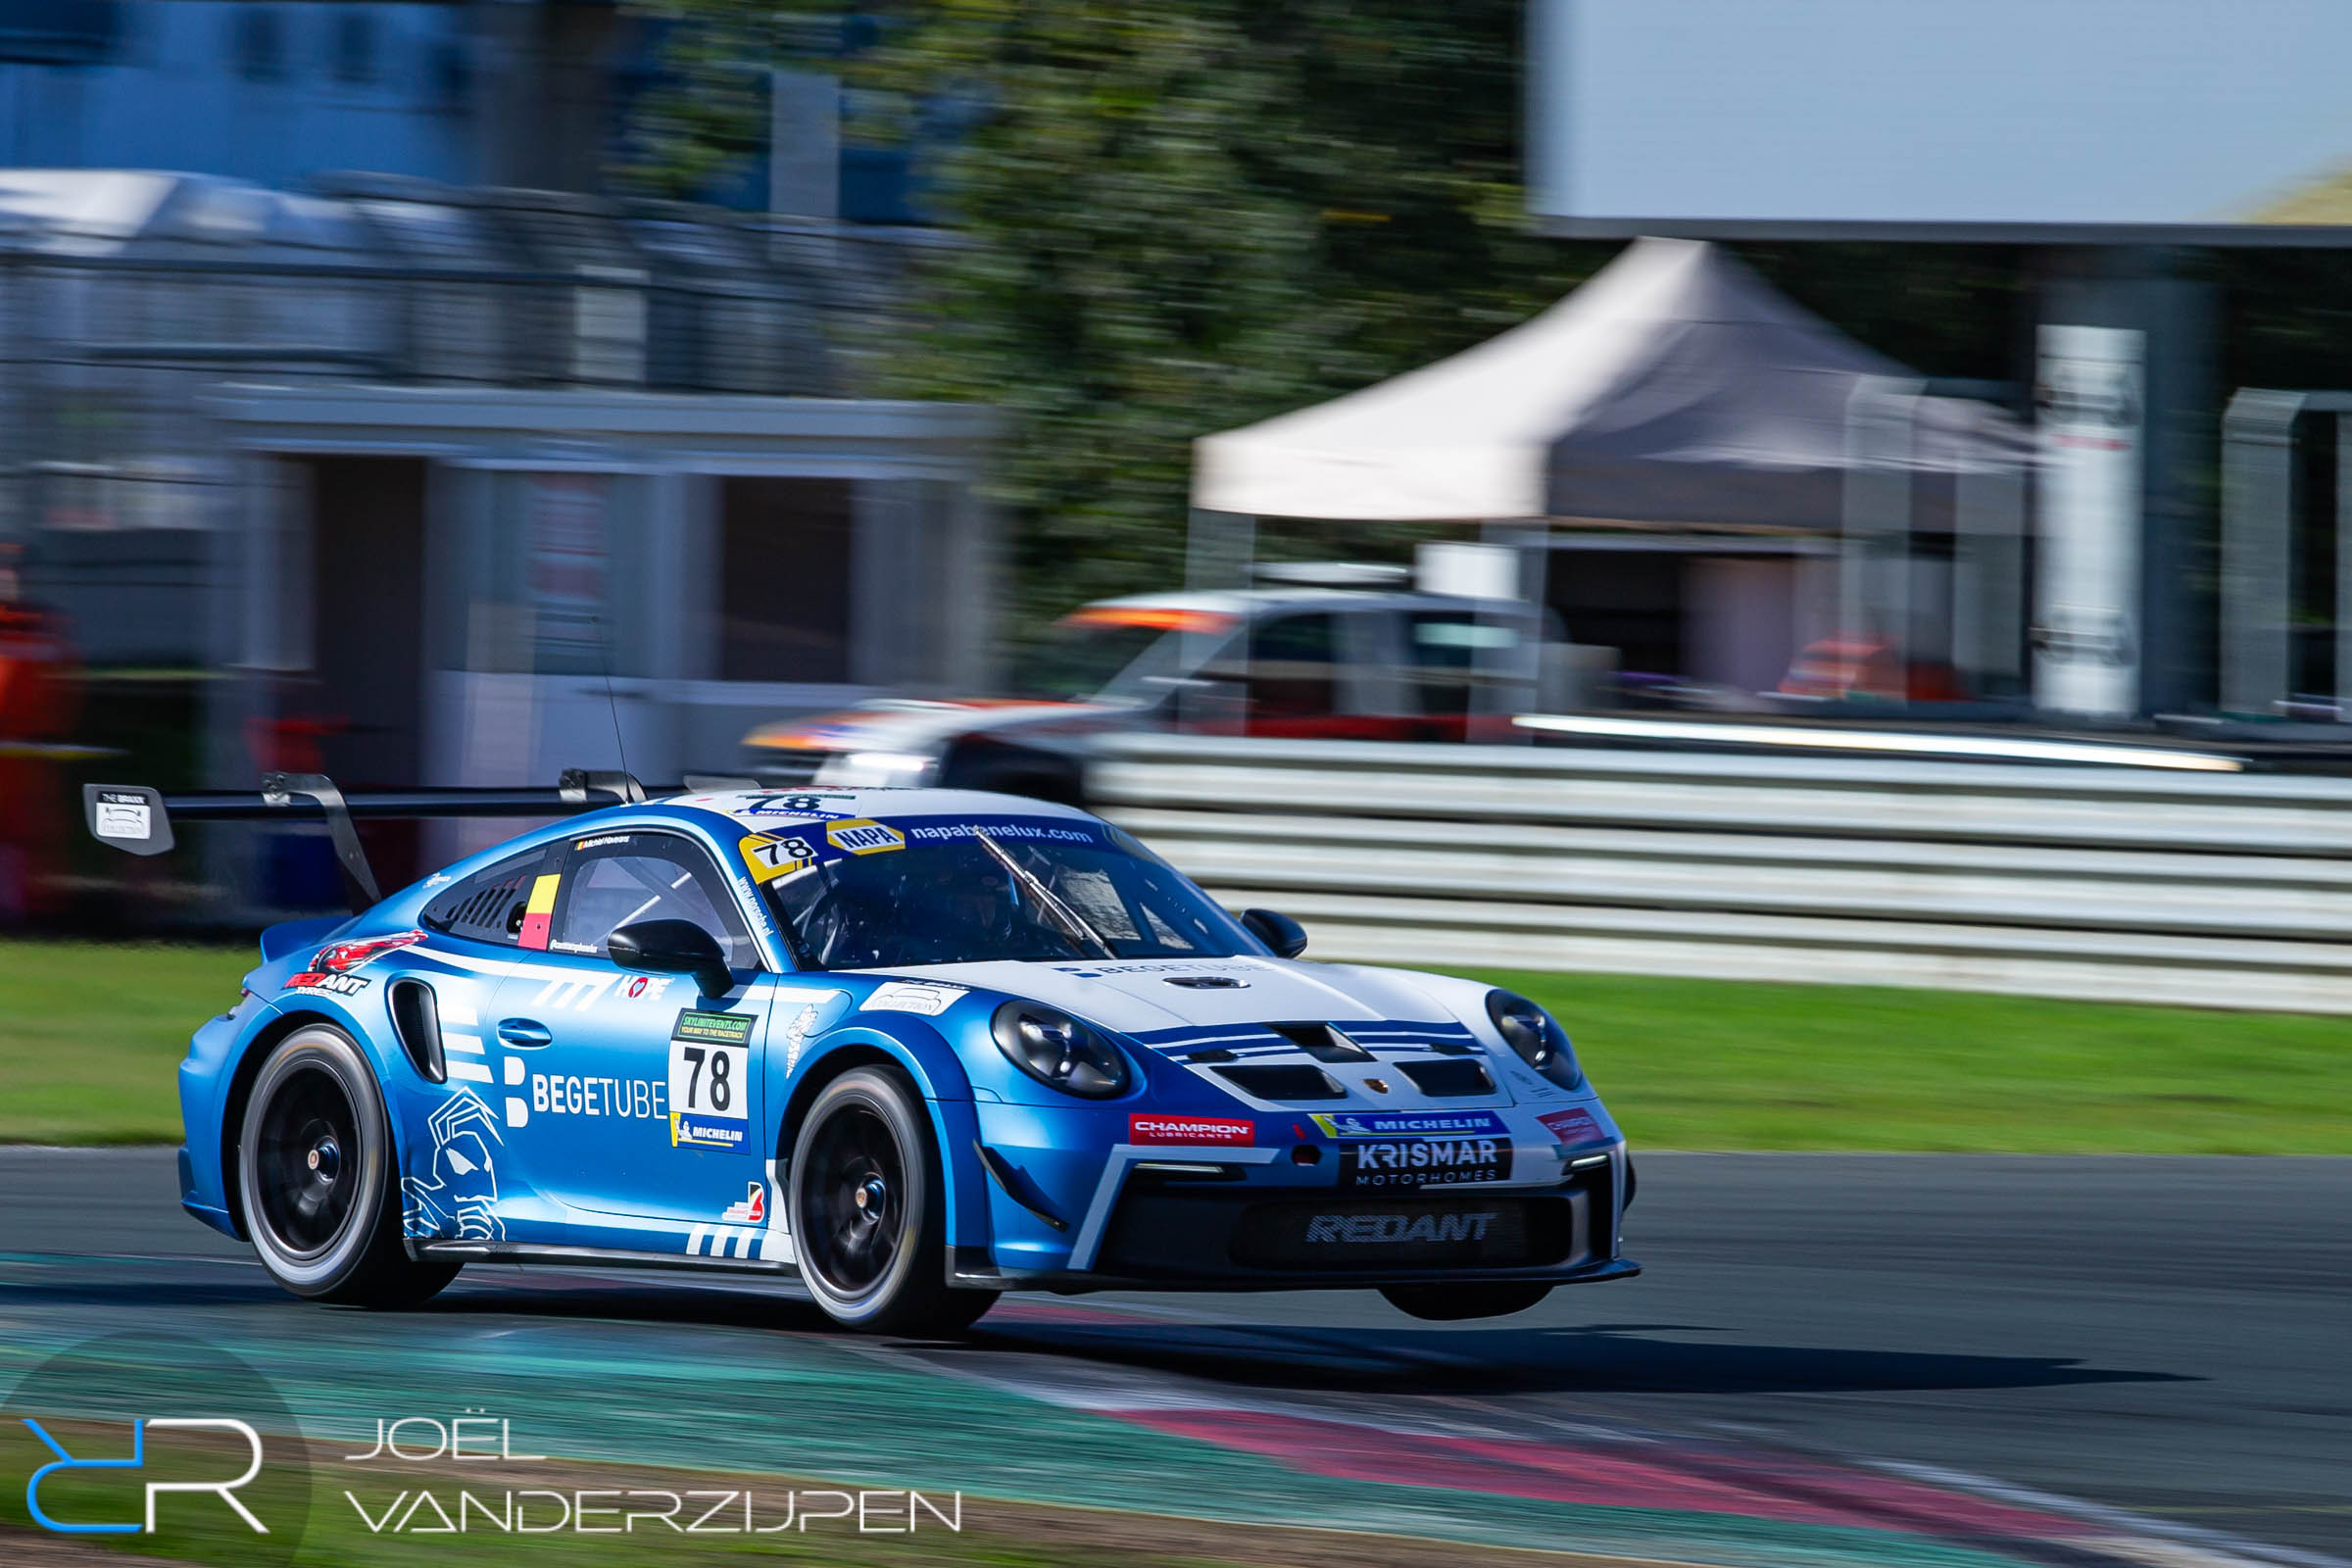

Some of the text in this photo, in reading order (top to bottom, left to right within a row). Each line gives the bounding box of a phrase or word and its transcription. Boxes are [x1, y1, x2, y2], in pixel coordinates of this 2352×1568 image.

[746, 796, 821, 810] 78
[756, 809, 839, 820] MICHELIN
[835, 827, 899, 849] NAPA
[910, 823, 1094, 843] napabenelux.com
[753, 839, 813, 865] 78
[683, 1016, 748, 1031] SKYLIMITEVENTS.COM
[683, 1047, 731, 1111] 78
[532, 1074, 667, 1119] BEGETUBE
[1135, 1121, 1250, 1135] CHAMPION
[1375, 1117, 1491, 1130] MICHELIN
[693, 1126, 744, 1142] MICHELIN
[1357, 1140, 1497, 1169] KRISMAR
[1356, 1169, 1497, 1186] MOTORHOMES
[1305, 1212, 1500, 1242] REDANT
